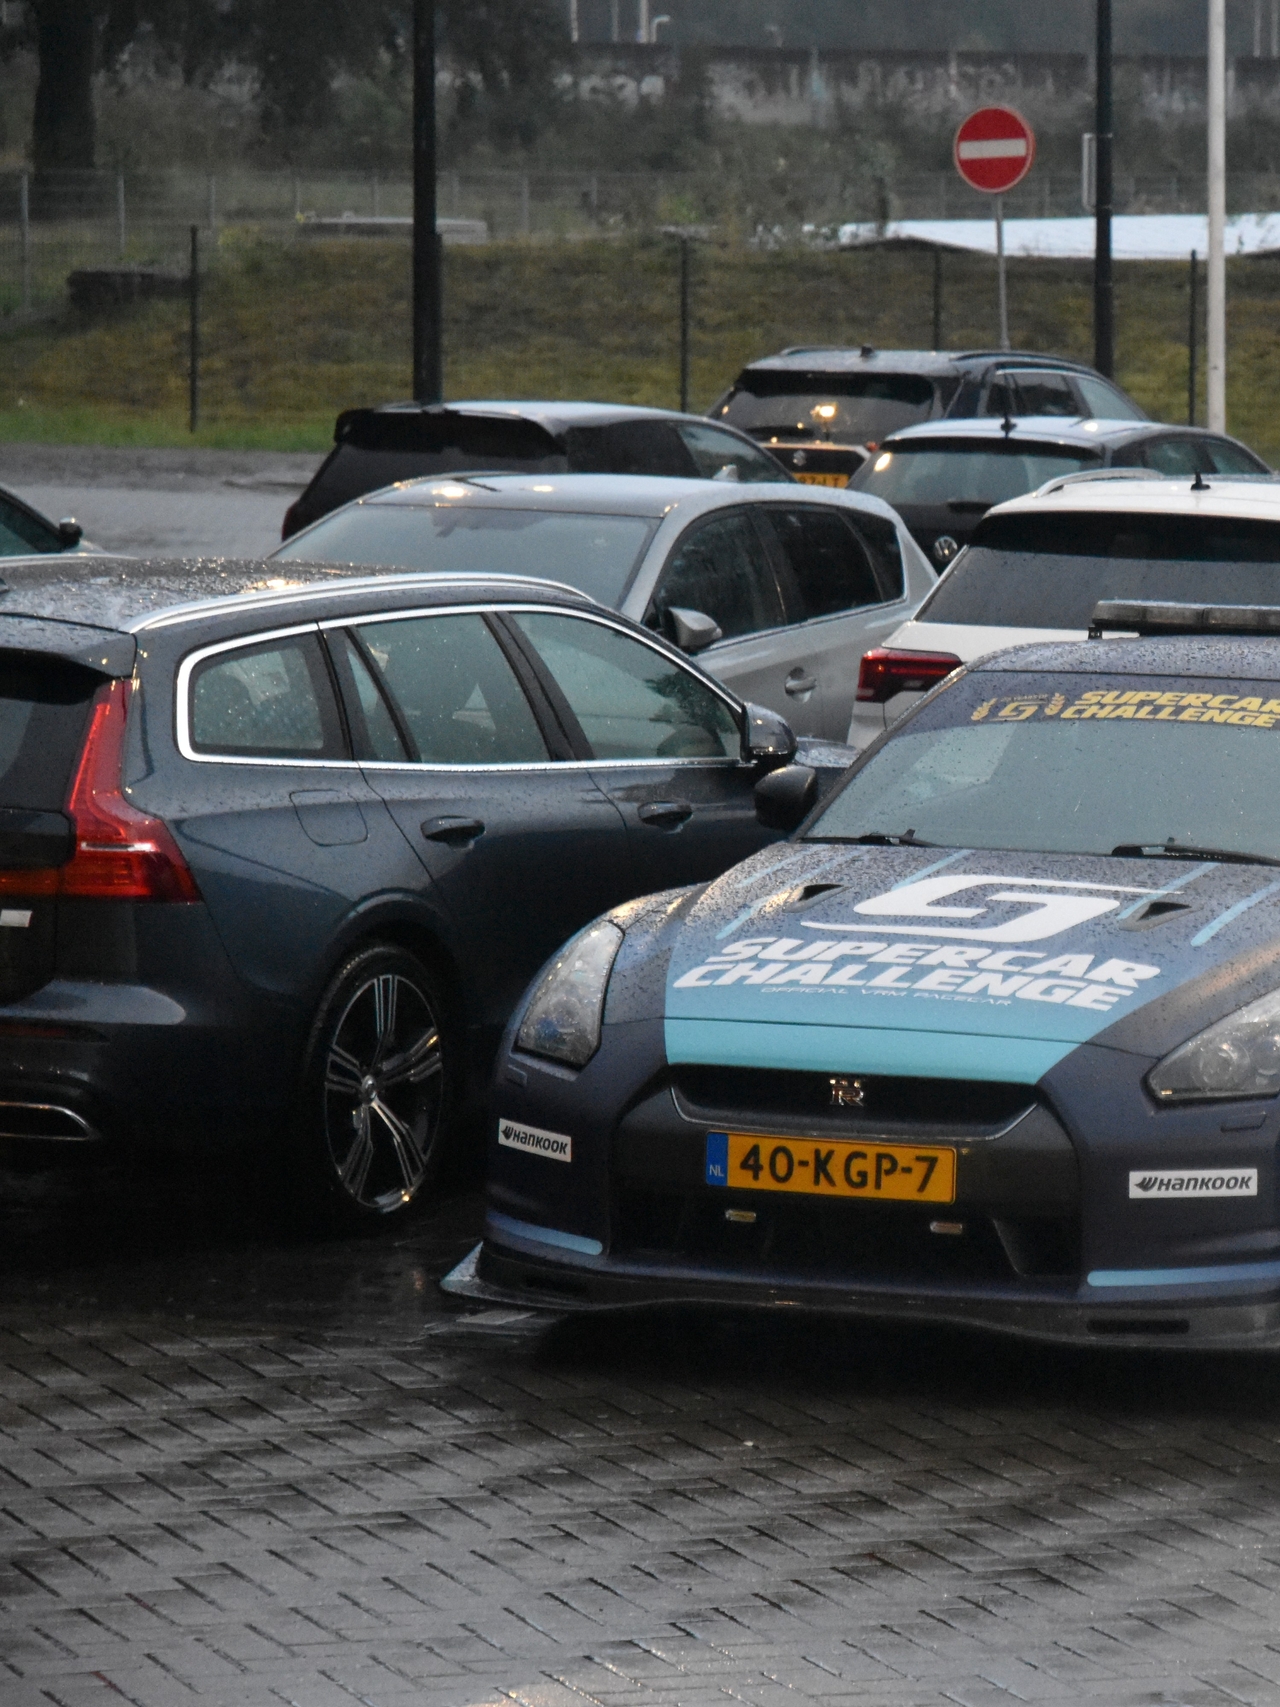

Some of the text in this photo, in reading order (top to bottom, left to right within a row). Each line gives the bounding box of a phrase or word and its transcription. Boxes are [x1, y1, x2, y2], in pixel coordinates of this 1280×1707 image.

[673, 962, 1134, 1011] CHALLENGE
[705, 937, 1161, 988] SUPERCAR
[760, 987, 849, 995] OFFICIAL
[709, 1164, 725, 1177] NL
[739, 1144, 939, 1192] 40-KGP-7
